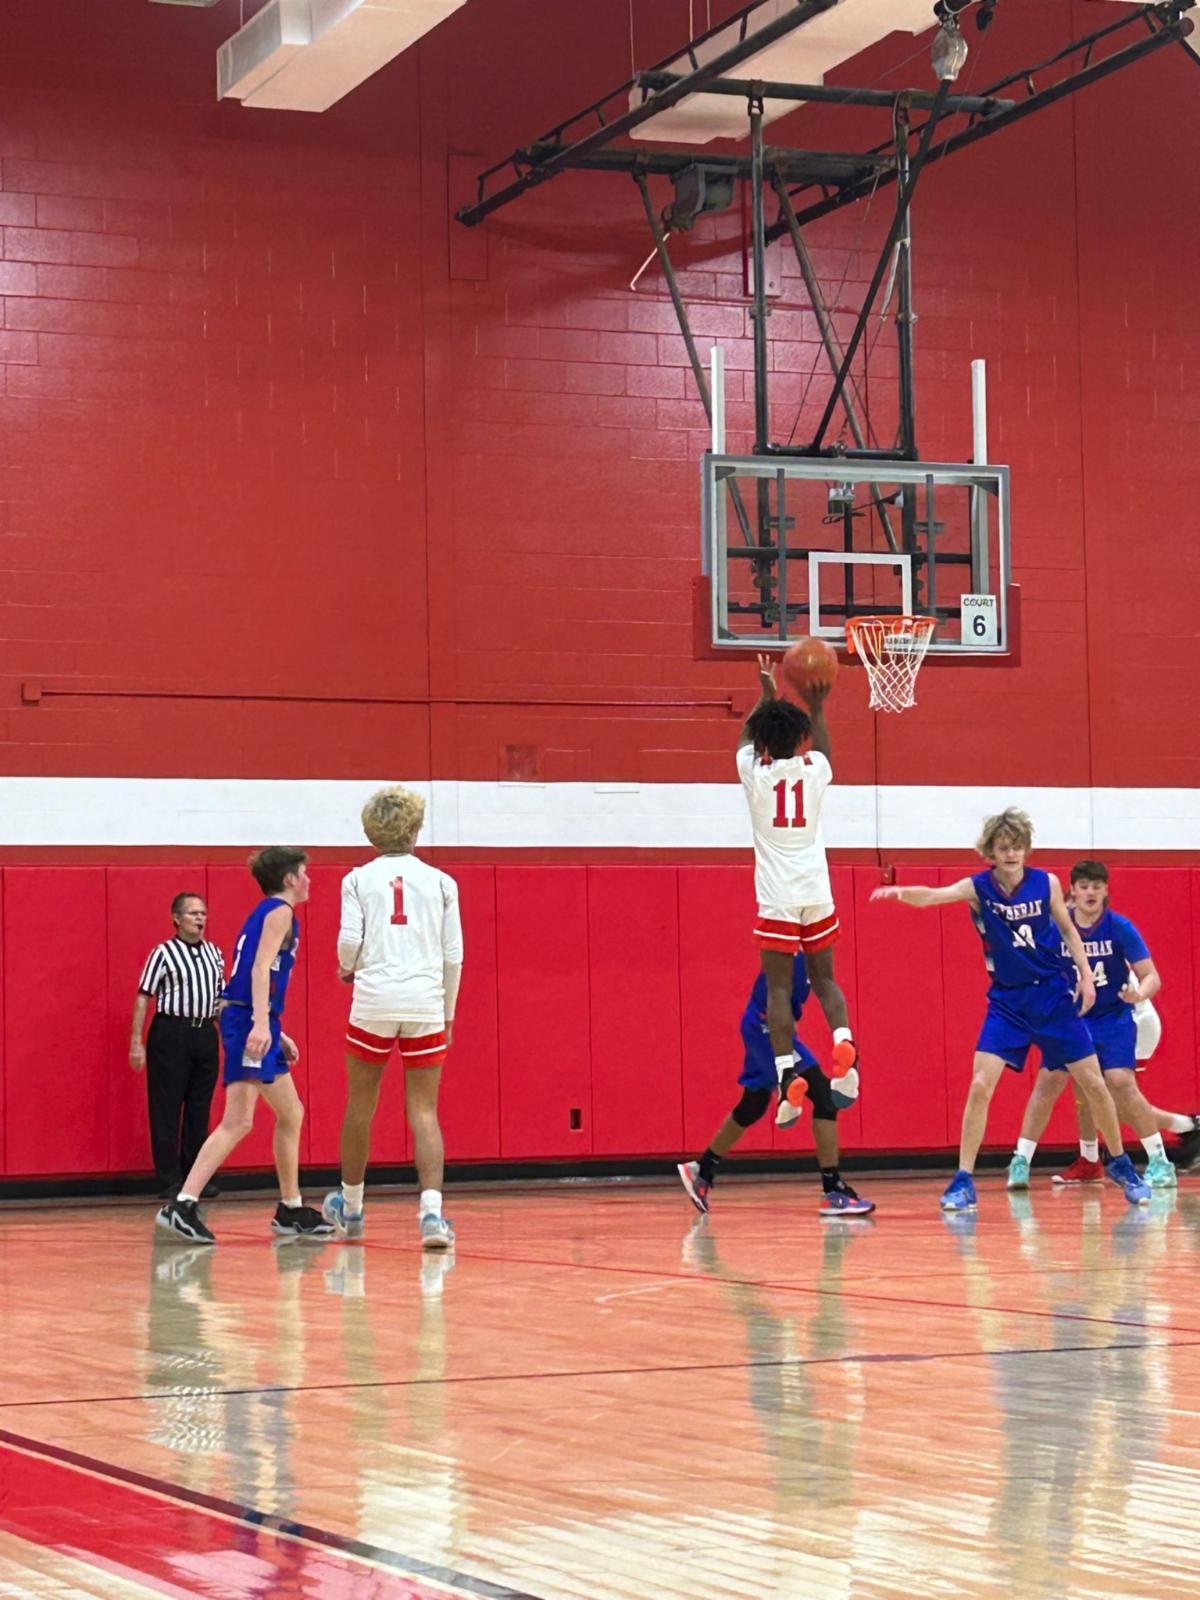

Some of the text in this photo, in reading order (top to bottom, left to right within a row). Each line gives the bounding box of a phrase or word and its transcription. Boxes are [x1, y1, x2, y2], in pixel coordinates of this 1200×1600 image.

[963, 598, 994, 607] COURT
[973, 615, 986, 637] 6
[773, 779, 807, 828] 11
[389, 876, 408, 925] 1
